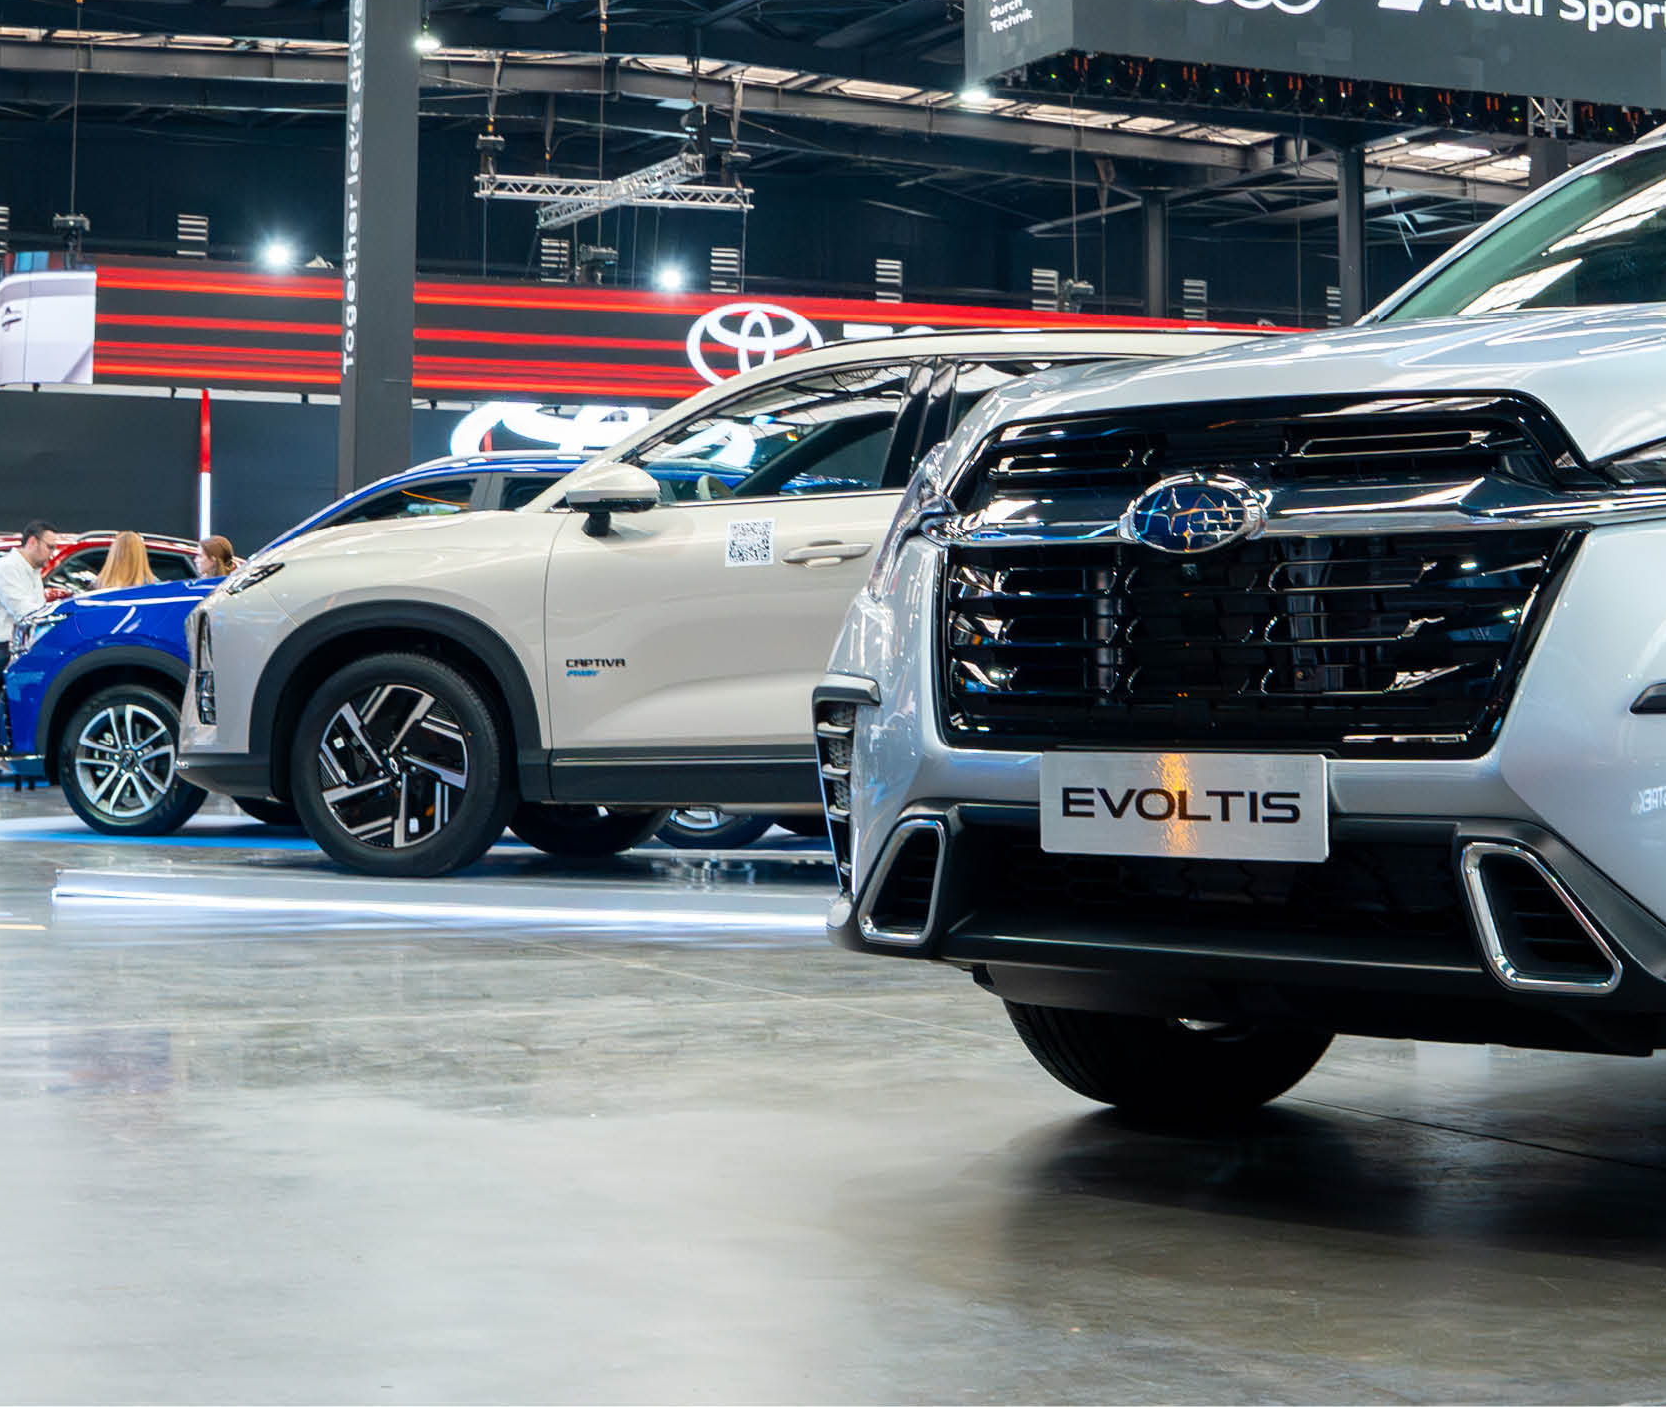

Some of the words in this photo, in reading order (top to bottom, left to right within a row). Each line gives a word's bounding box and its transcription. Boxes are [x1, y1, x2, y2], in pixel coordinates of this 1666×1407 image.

[989, 8, 1033, 33] Technik
[342, 192, 358, 375] Together
[565, 658, 626, 668] CAPTIVA
[1061, 787, 1301, 824] EVOLTIS
